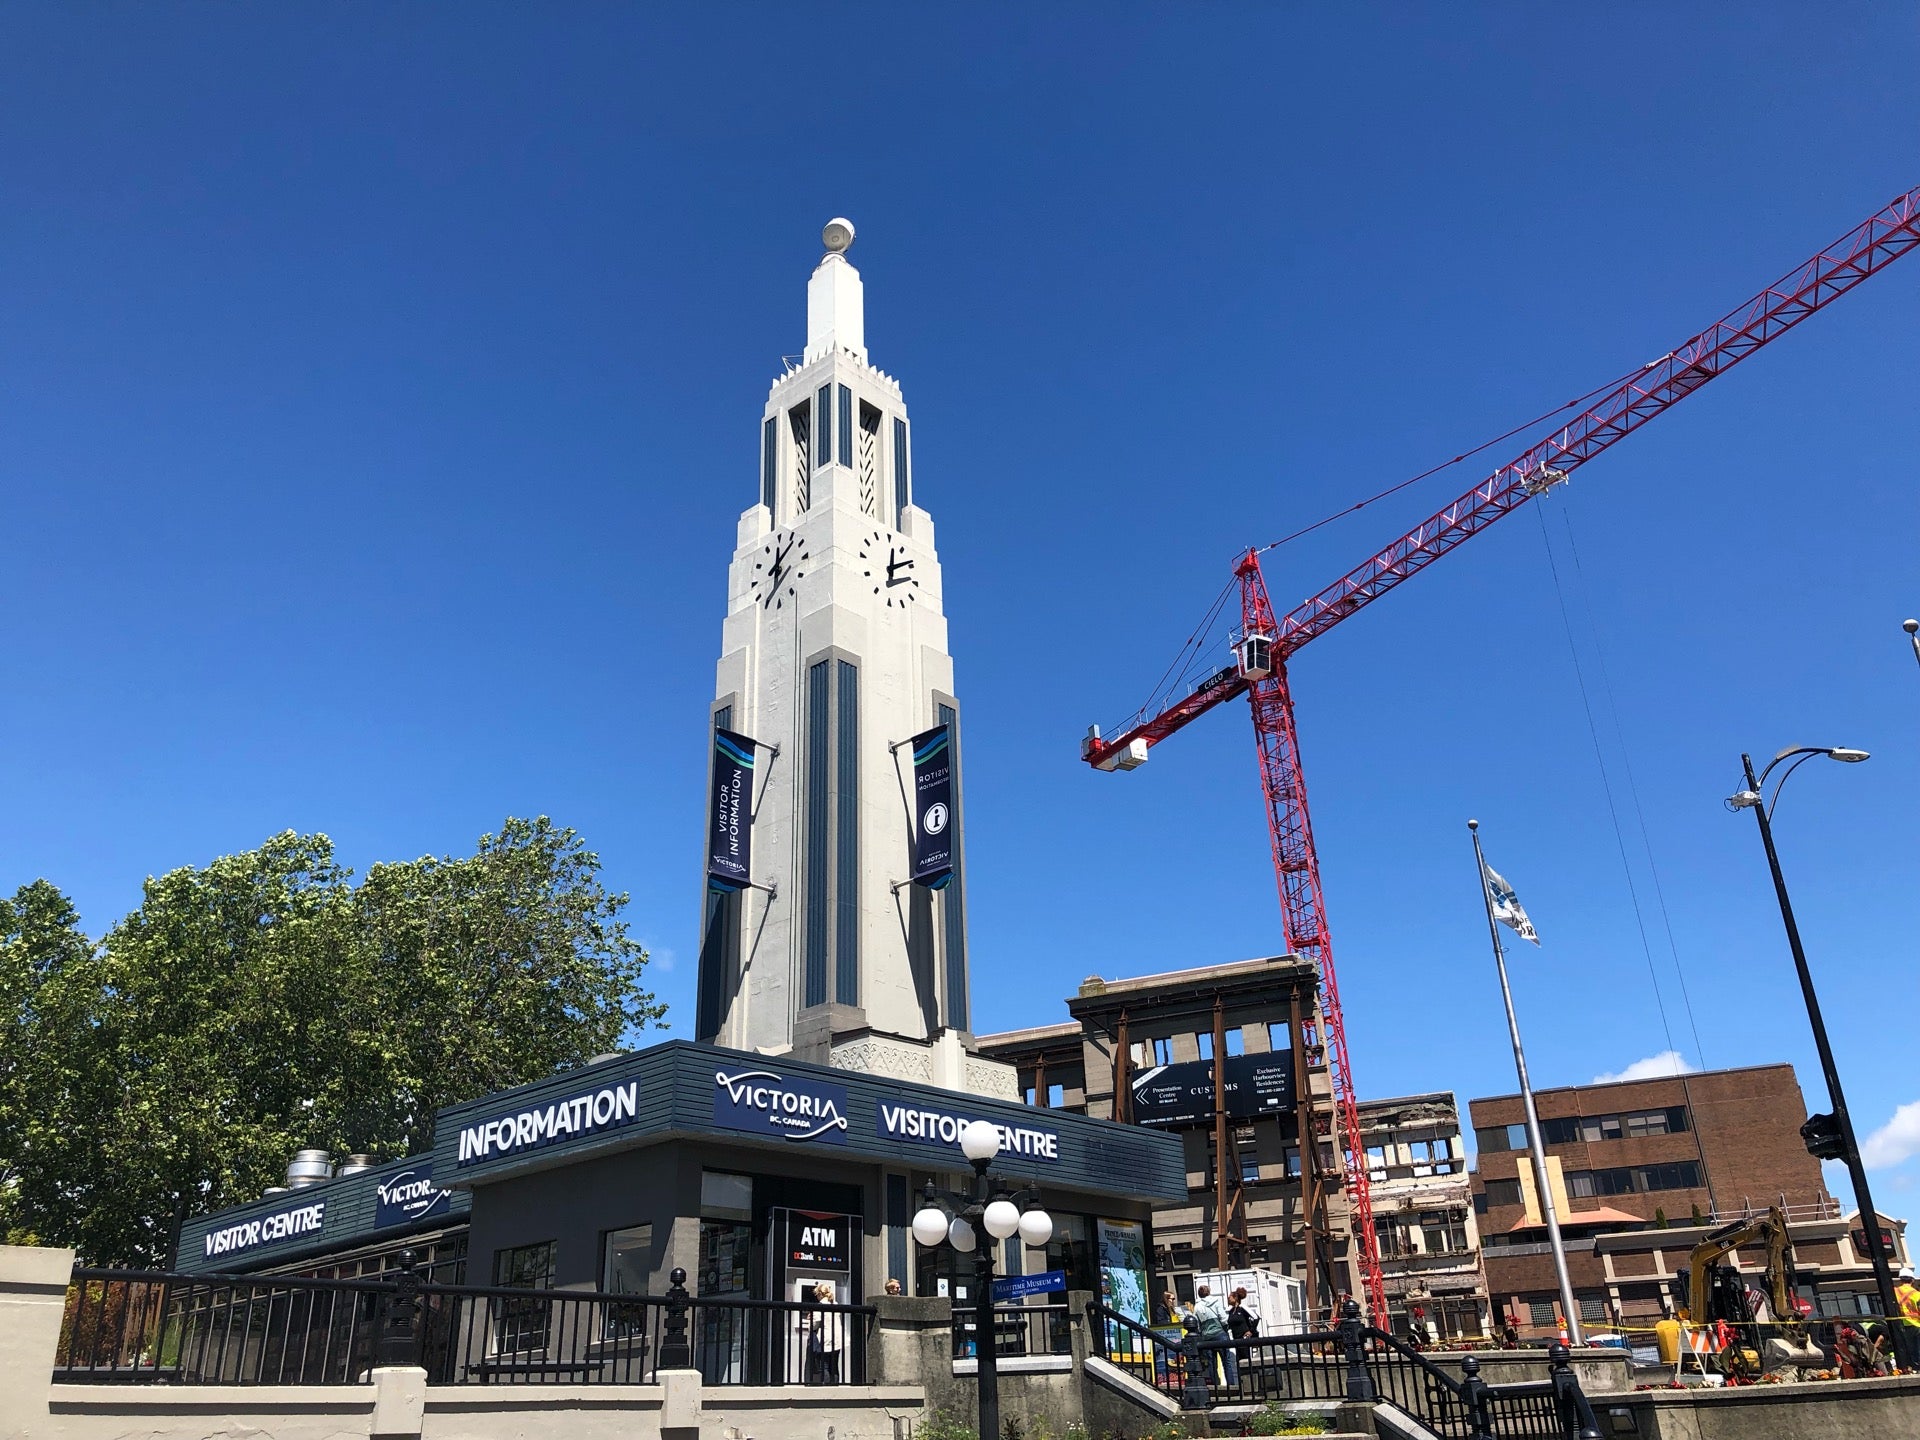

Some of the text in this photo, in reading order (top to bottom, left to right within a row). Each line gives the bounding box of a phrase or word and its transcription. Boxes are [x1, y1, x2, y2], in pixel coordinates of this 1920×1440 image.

[1204, 673, 1224, 689] CIELO
[719, 784, 729, 832] VISITOR
[730, 769, 742, 855] INFORMATION
[714, 856, 746, 871] VICTORIA
[718, 1078, 843, 1124] VICTORIA
[1190, 1082, 1239, 1095] CUSTMS
[458, 1082, 637, 1161] INFORMATION
[783, 1117, 811, 1128] CANADA
[992, 1124, 1058, 1158] ENTRE
[205, 1203, 325, 1256] VISITOR CENTRE
[801, 1226, 835, 1248] ATM
[1026, 1278, 1052, 1288] MUSEUM
